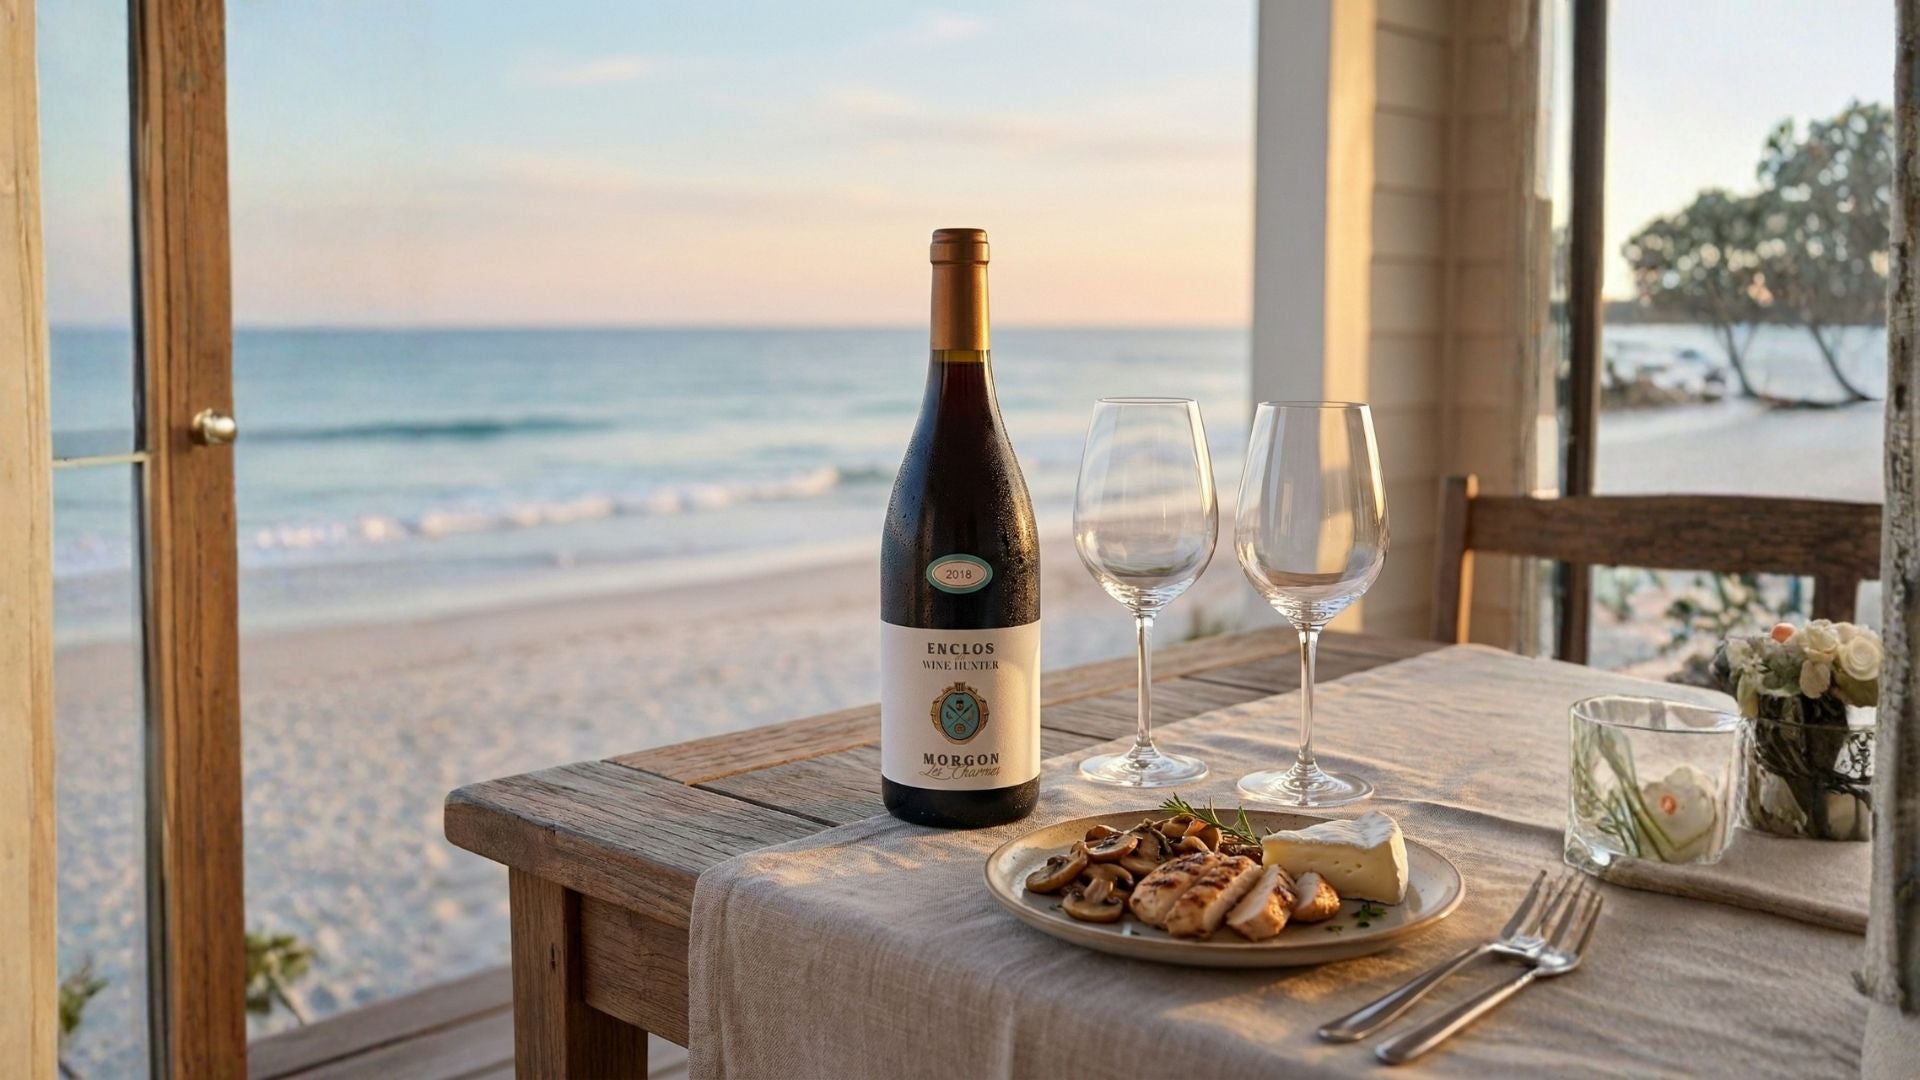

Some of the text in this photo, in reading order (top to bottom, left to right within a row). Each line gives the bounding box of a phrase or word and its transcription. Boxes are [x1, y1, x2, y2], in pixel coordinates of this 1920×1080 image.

[946, 569, 972, 579] 2018
[927, 642, 994, 655] ENCLOS
[922, 660, 999, 671] WINE HUNTER
[923, 752, 999, 766] MORGON
